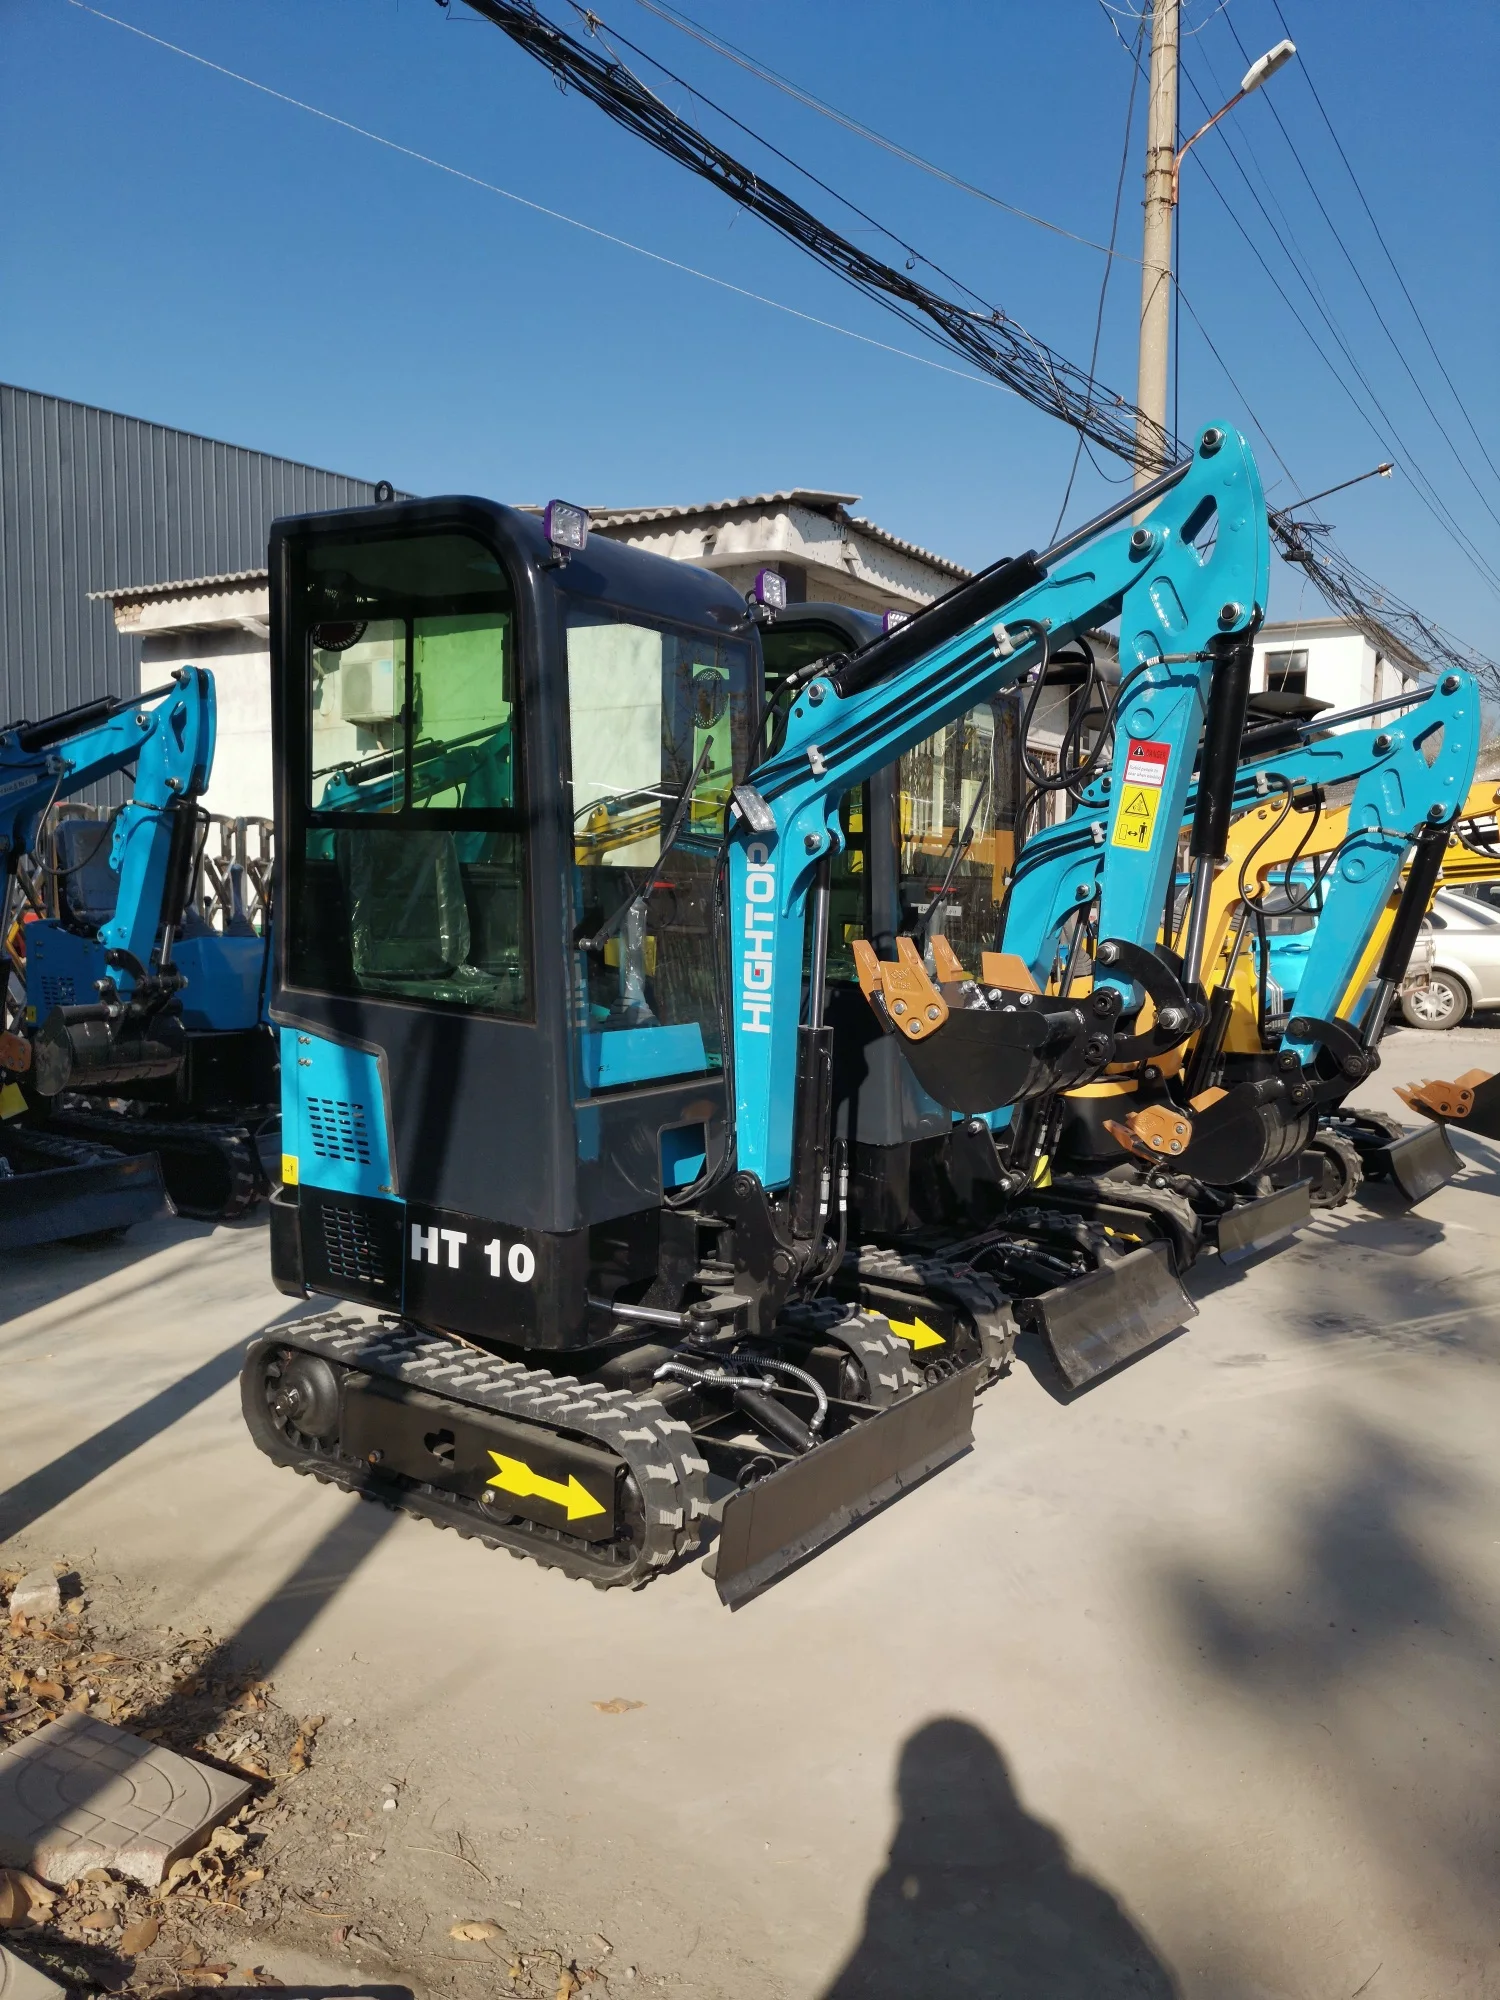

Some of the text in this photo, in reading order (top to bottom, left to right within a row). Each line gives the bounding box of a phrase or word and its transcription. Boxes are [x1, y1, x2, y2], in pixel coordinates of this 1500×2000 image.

[742, 842, 776, 1034] HIGHTOP
[411, 1223, 535, 1283] HT 10
